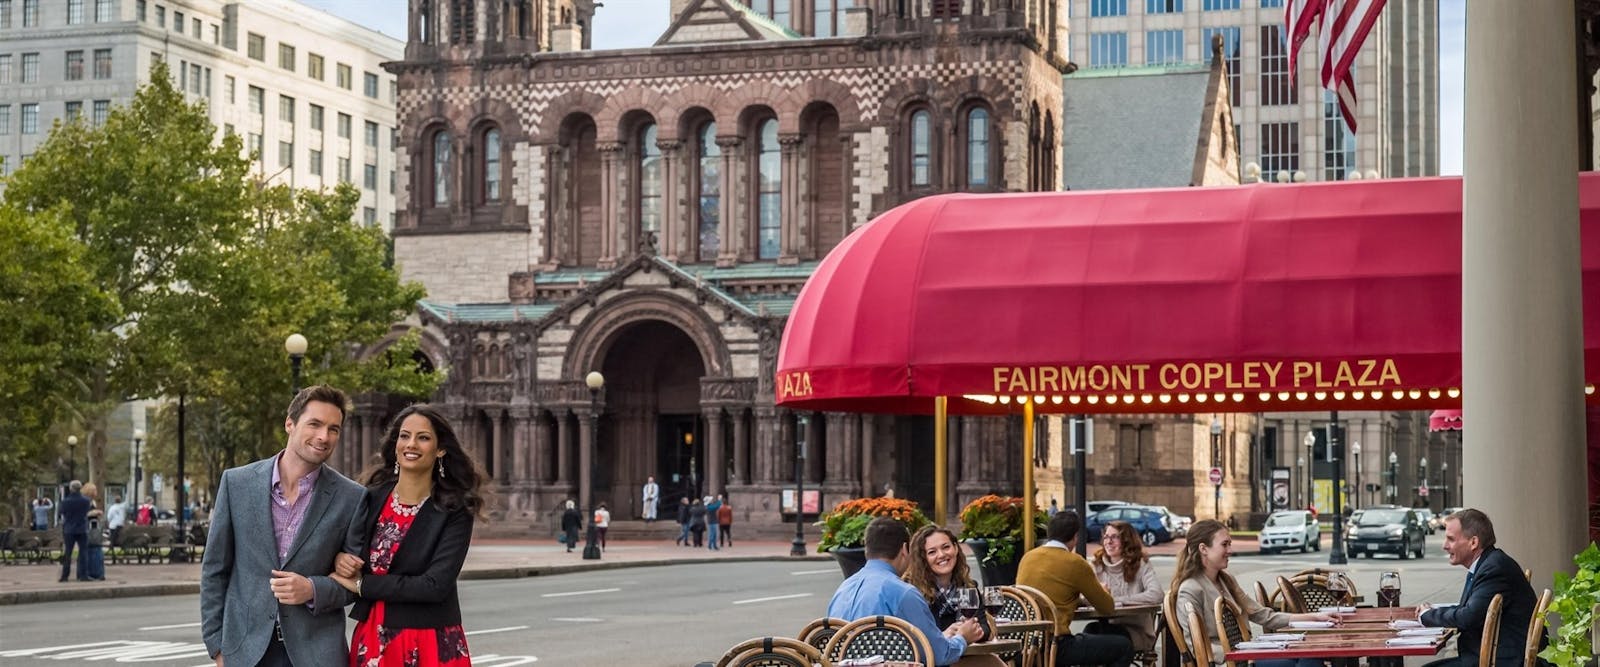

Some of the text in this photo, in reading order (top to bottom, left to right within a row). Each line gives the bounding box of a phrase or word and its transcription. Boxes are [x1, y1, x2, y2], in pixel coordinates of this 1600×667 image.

[993, 359, 1401, 392] FAIRMONT COPLEY PLAZA
